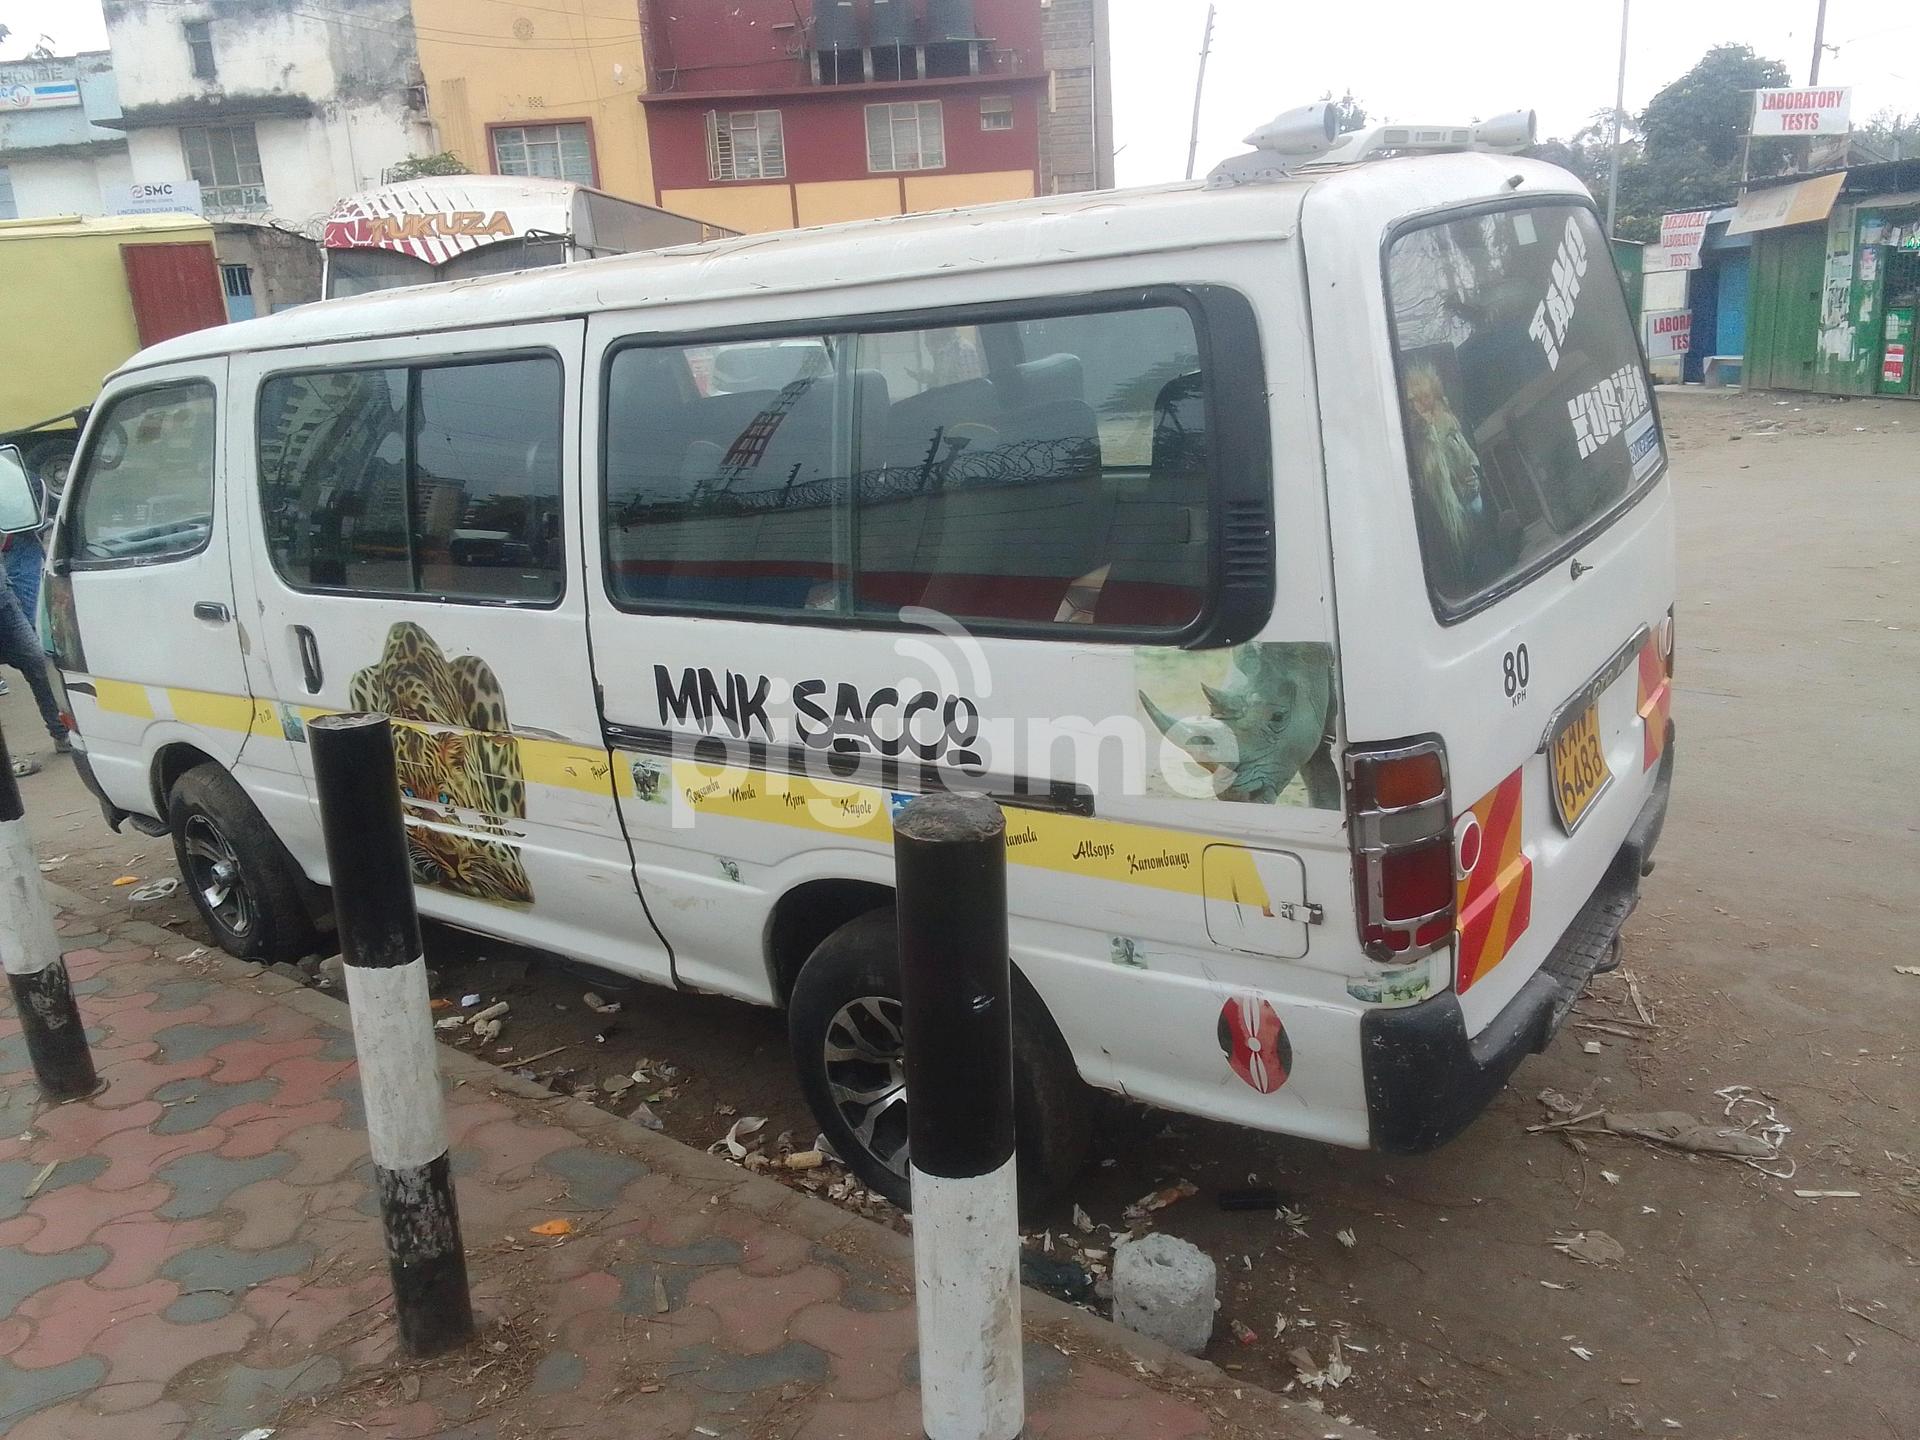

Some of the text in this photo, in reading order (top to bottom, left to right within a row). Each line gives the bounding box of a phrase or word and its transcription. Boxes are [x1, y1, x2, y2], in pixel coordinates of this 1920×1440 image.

[1762, 91, 1844, 111] LABORATORY
[1781, 113, 1819, 131] TESTS
[144, 184, 173, 196] SMC
[367, 211, 514, 245] TUKUZA
[1503, 643, 1529, 698] 80
[1512, 689, 1527, 708] KPH
[653, 664, 982, 766] MNK SACCO
[840, 798, 873, 819] Kayole
[1072, 839, 1115, 861] Allsops
